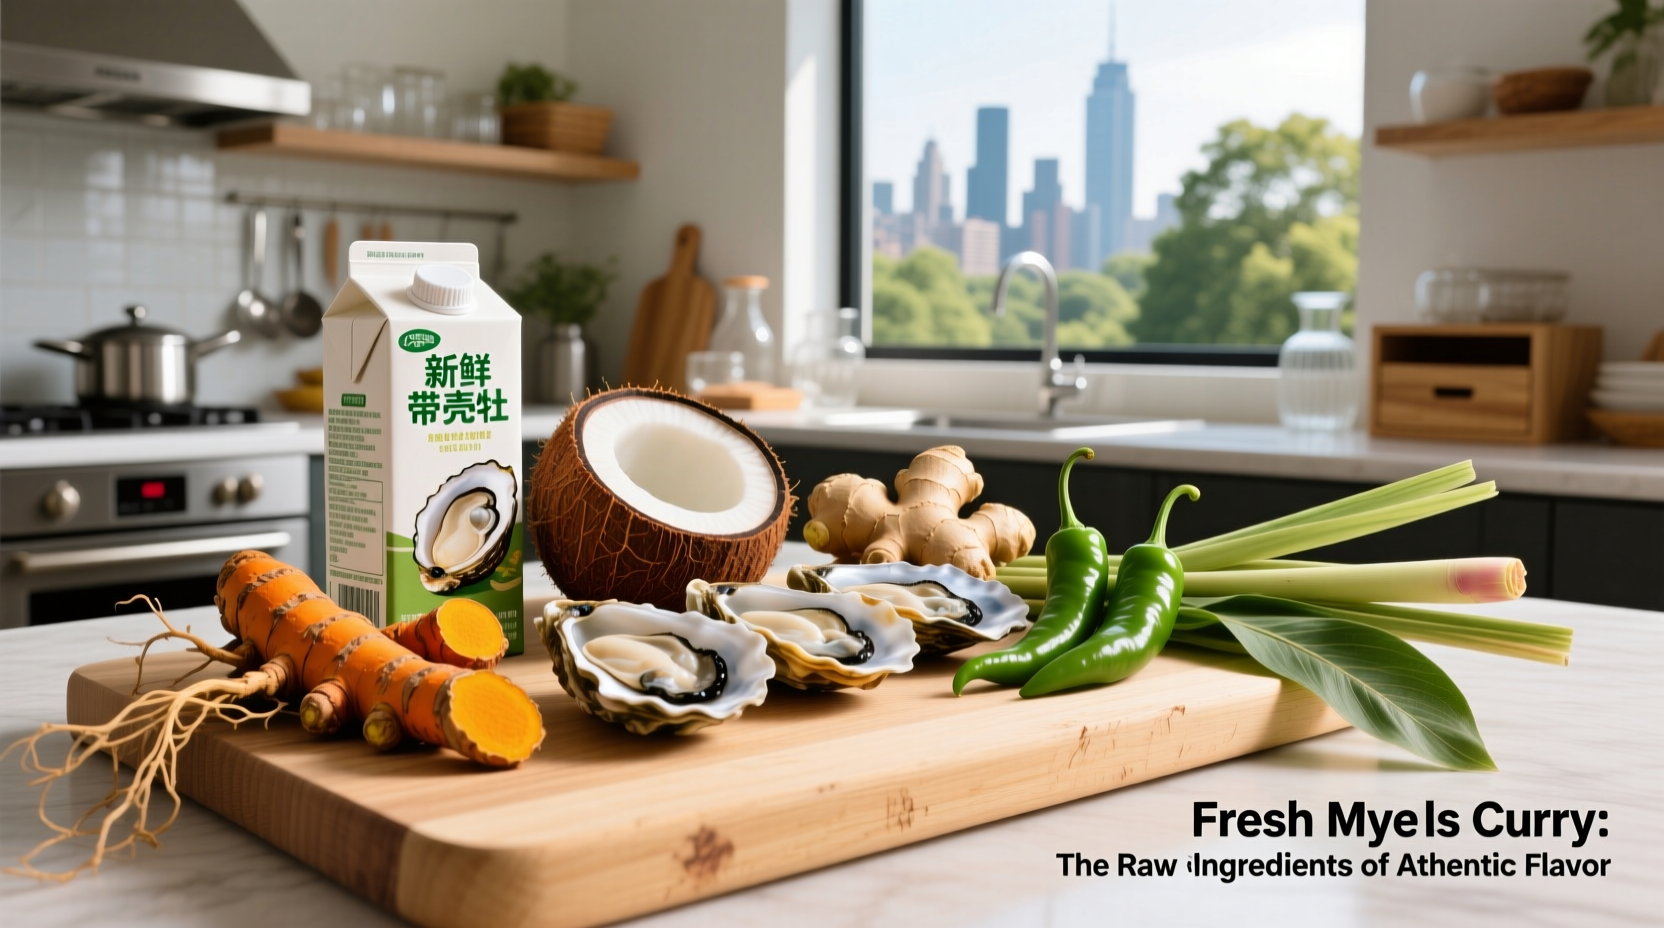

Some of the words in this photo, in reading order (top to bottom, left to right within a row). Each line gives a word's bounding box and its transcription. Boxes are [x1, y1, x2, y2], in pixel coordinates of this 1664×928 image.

[424, 353, 492, 388] 新鲜
[407, 388, 510, 426] 带壳牡
